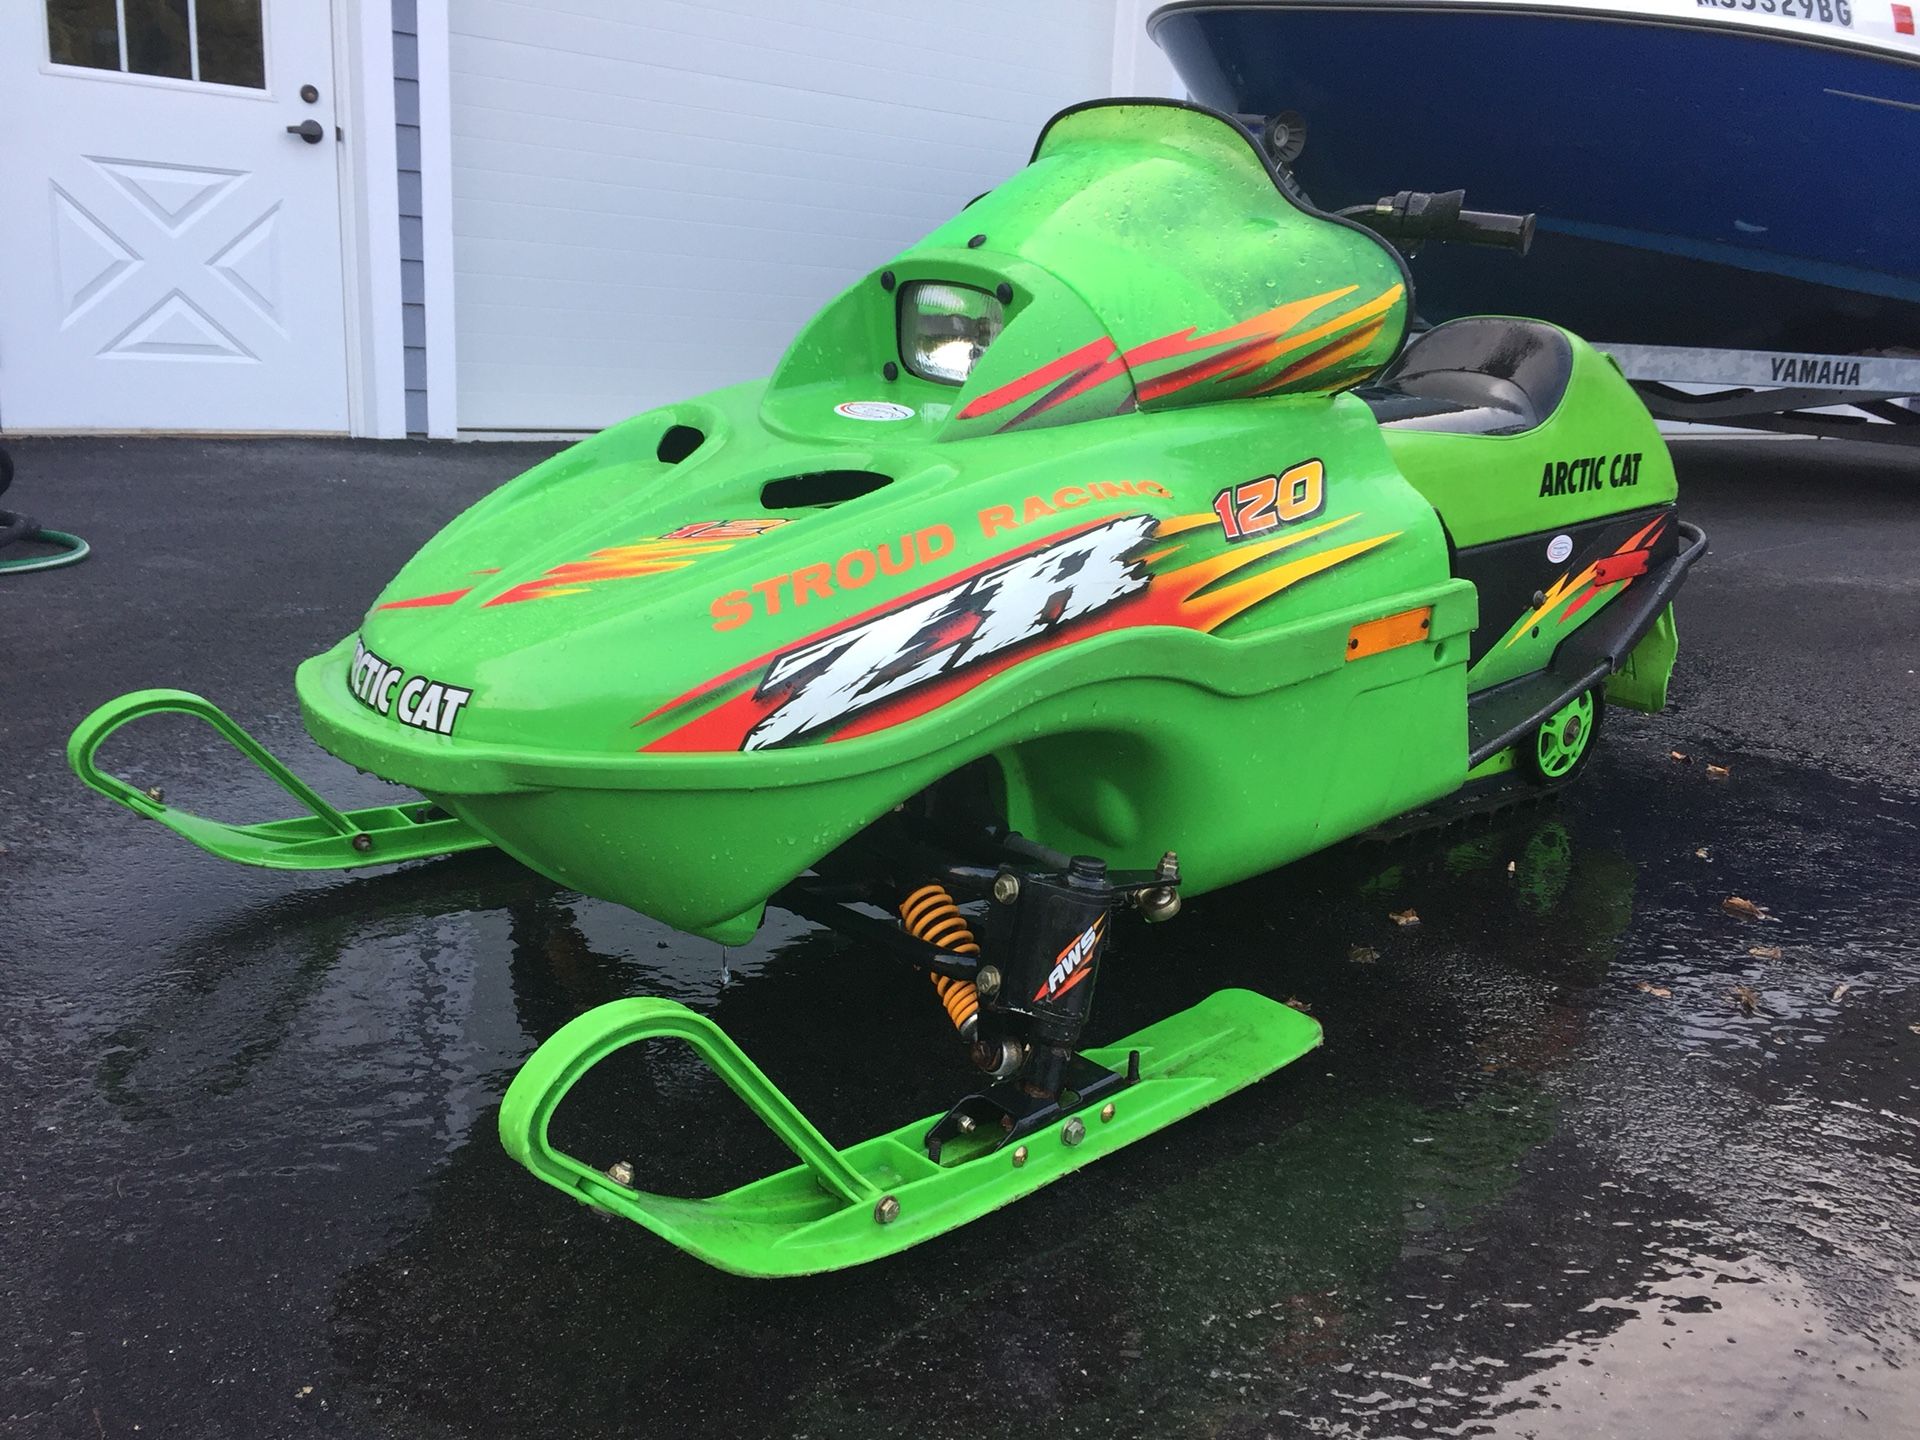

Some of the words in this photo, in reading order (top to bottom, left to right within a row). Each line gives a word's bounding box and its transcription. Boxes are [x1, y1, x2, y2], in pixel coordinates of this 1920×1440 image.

[1770, 357, 1861, 386] YAMAHA
[1213, 457, 1327, 544] 120
[1538, 456, 1606, 498] ARCTIC
[1609, 453, 1643, 489] CAT
[711, 524, 956, 632] STROUD
[978, 479, 1174, 539] RACING
[397, 675, 474, 737] CAT
[1048, 925, 1096, 993] AWS
